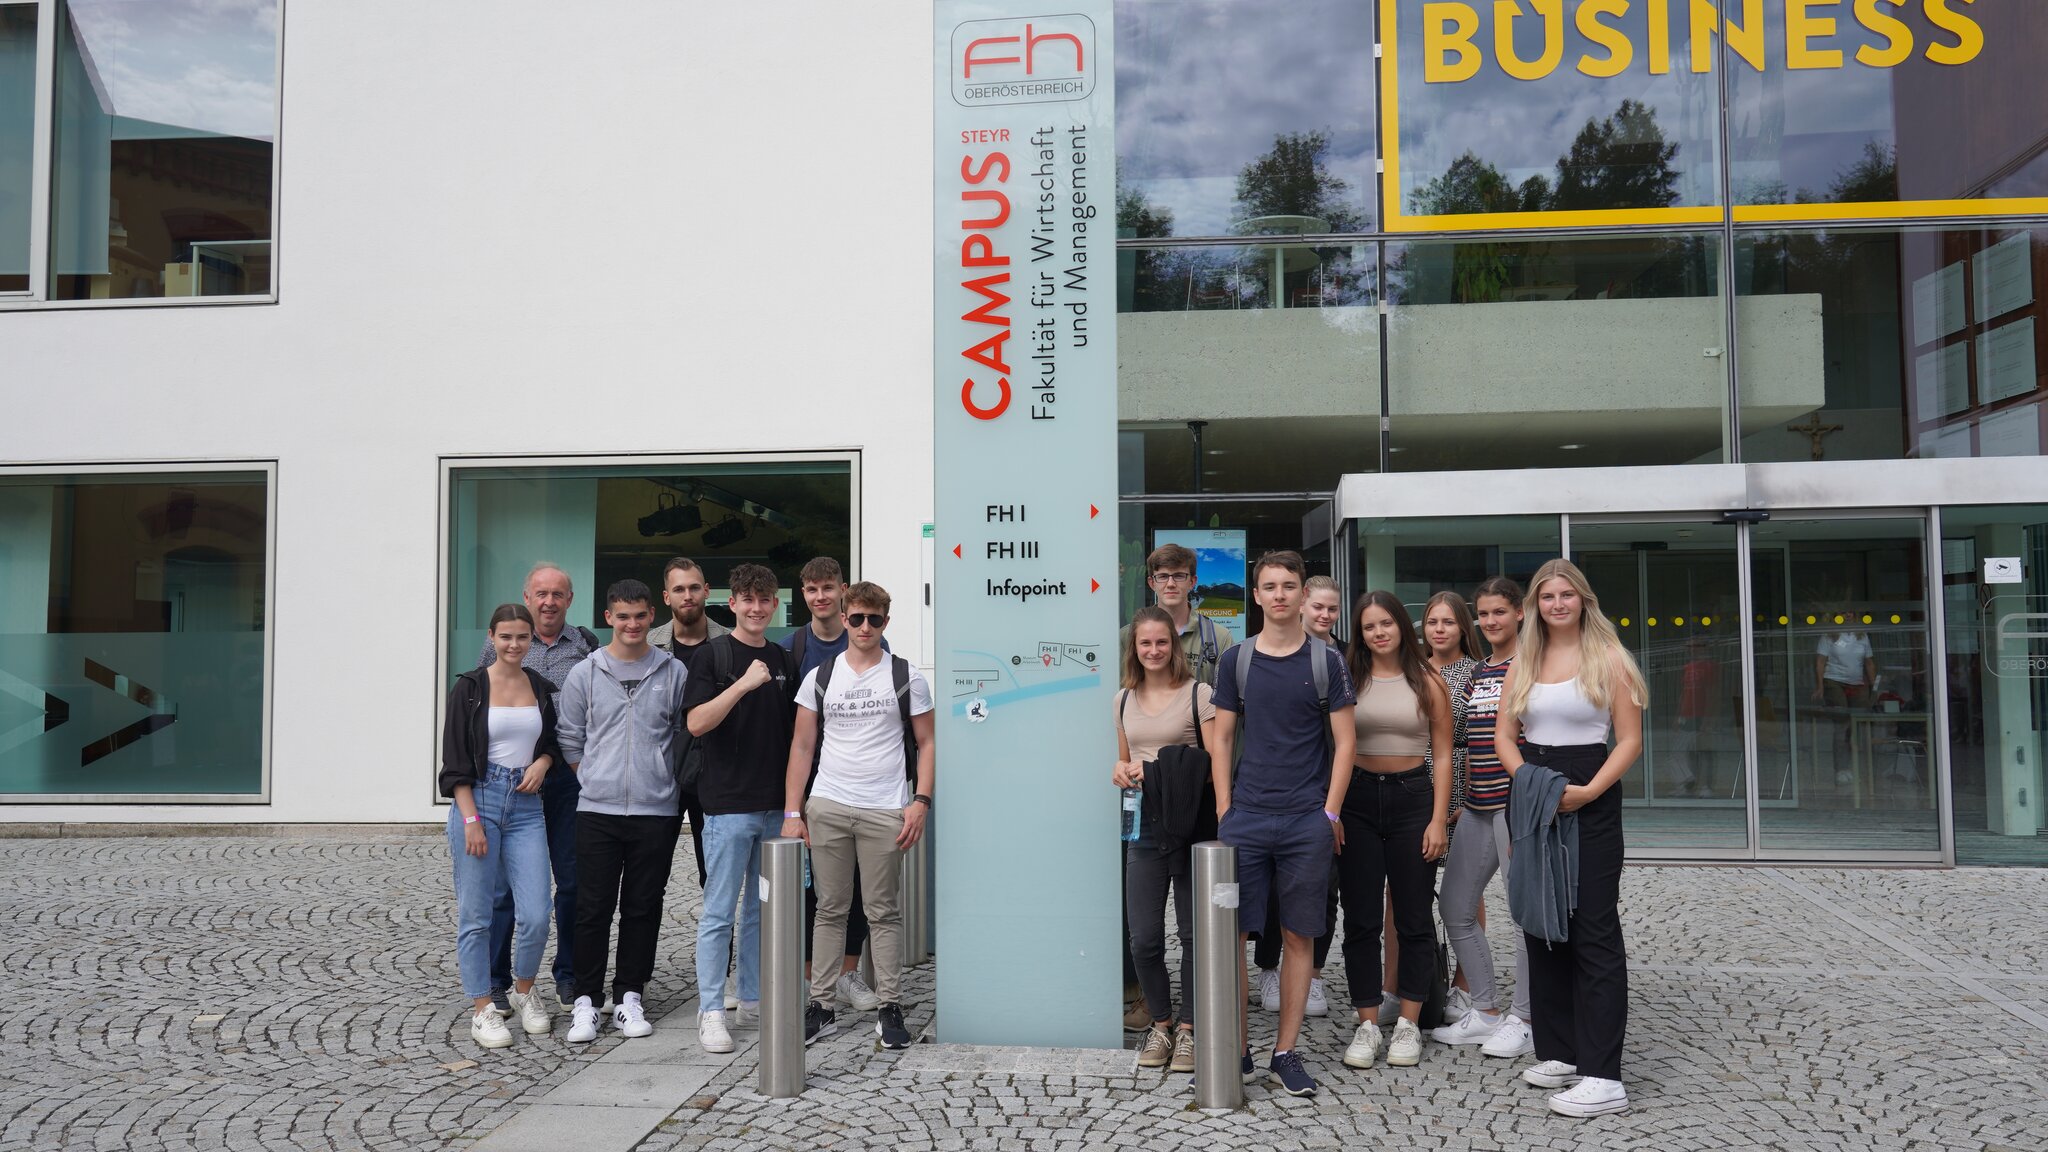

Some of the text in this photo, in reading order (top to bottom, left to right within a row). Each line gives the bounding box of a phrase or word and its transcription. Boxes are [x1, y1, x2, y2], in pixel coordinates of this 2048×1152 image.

[1423, 0, 1984, 83] BUSINESS
[964, 81, 1083, 99] OBERÖSTERREICH
[961, 128, 1010, 143] STEYR
[1063, 124, 1096, 347] und Management
[1031, 126, 1055, 420] Fakultät für Wirtschaft
[961, 151, 1011, 420] CAMPUS
[987, 504, 1025, 522] FH I
[987, 541, 1039, 559] FH III
[987, 578, 1067, 602] Infopoint
[2000, 658, 2048, 670] OBERÖ
[849, 702, 857, 711] &
[861, 698, 896, 709] JONES
